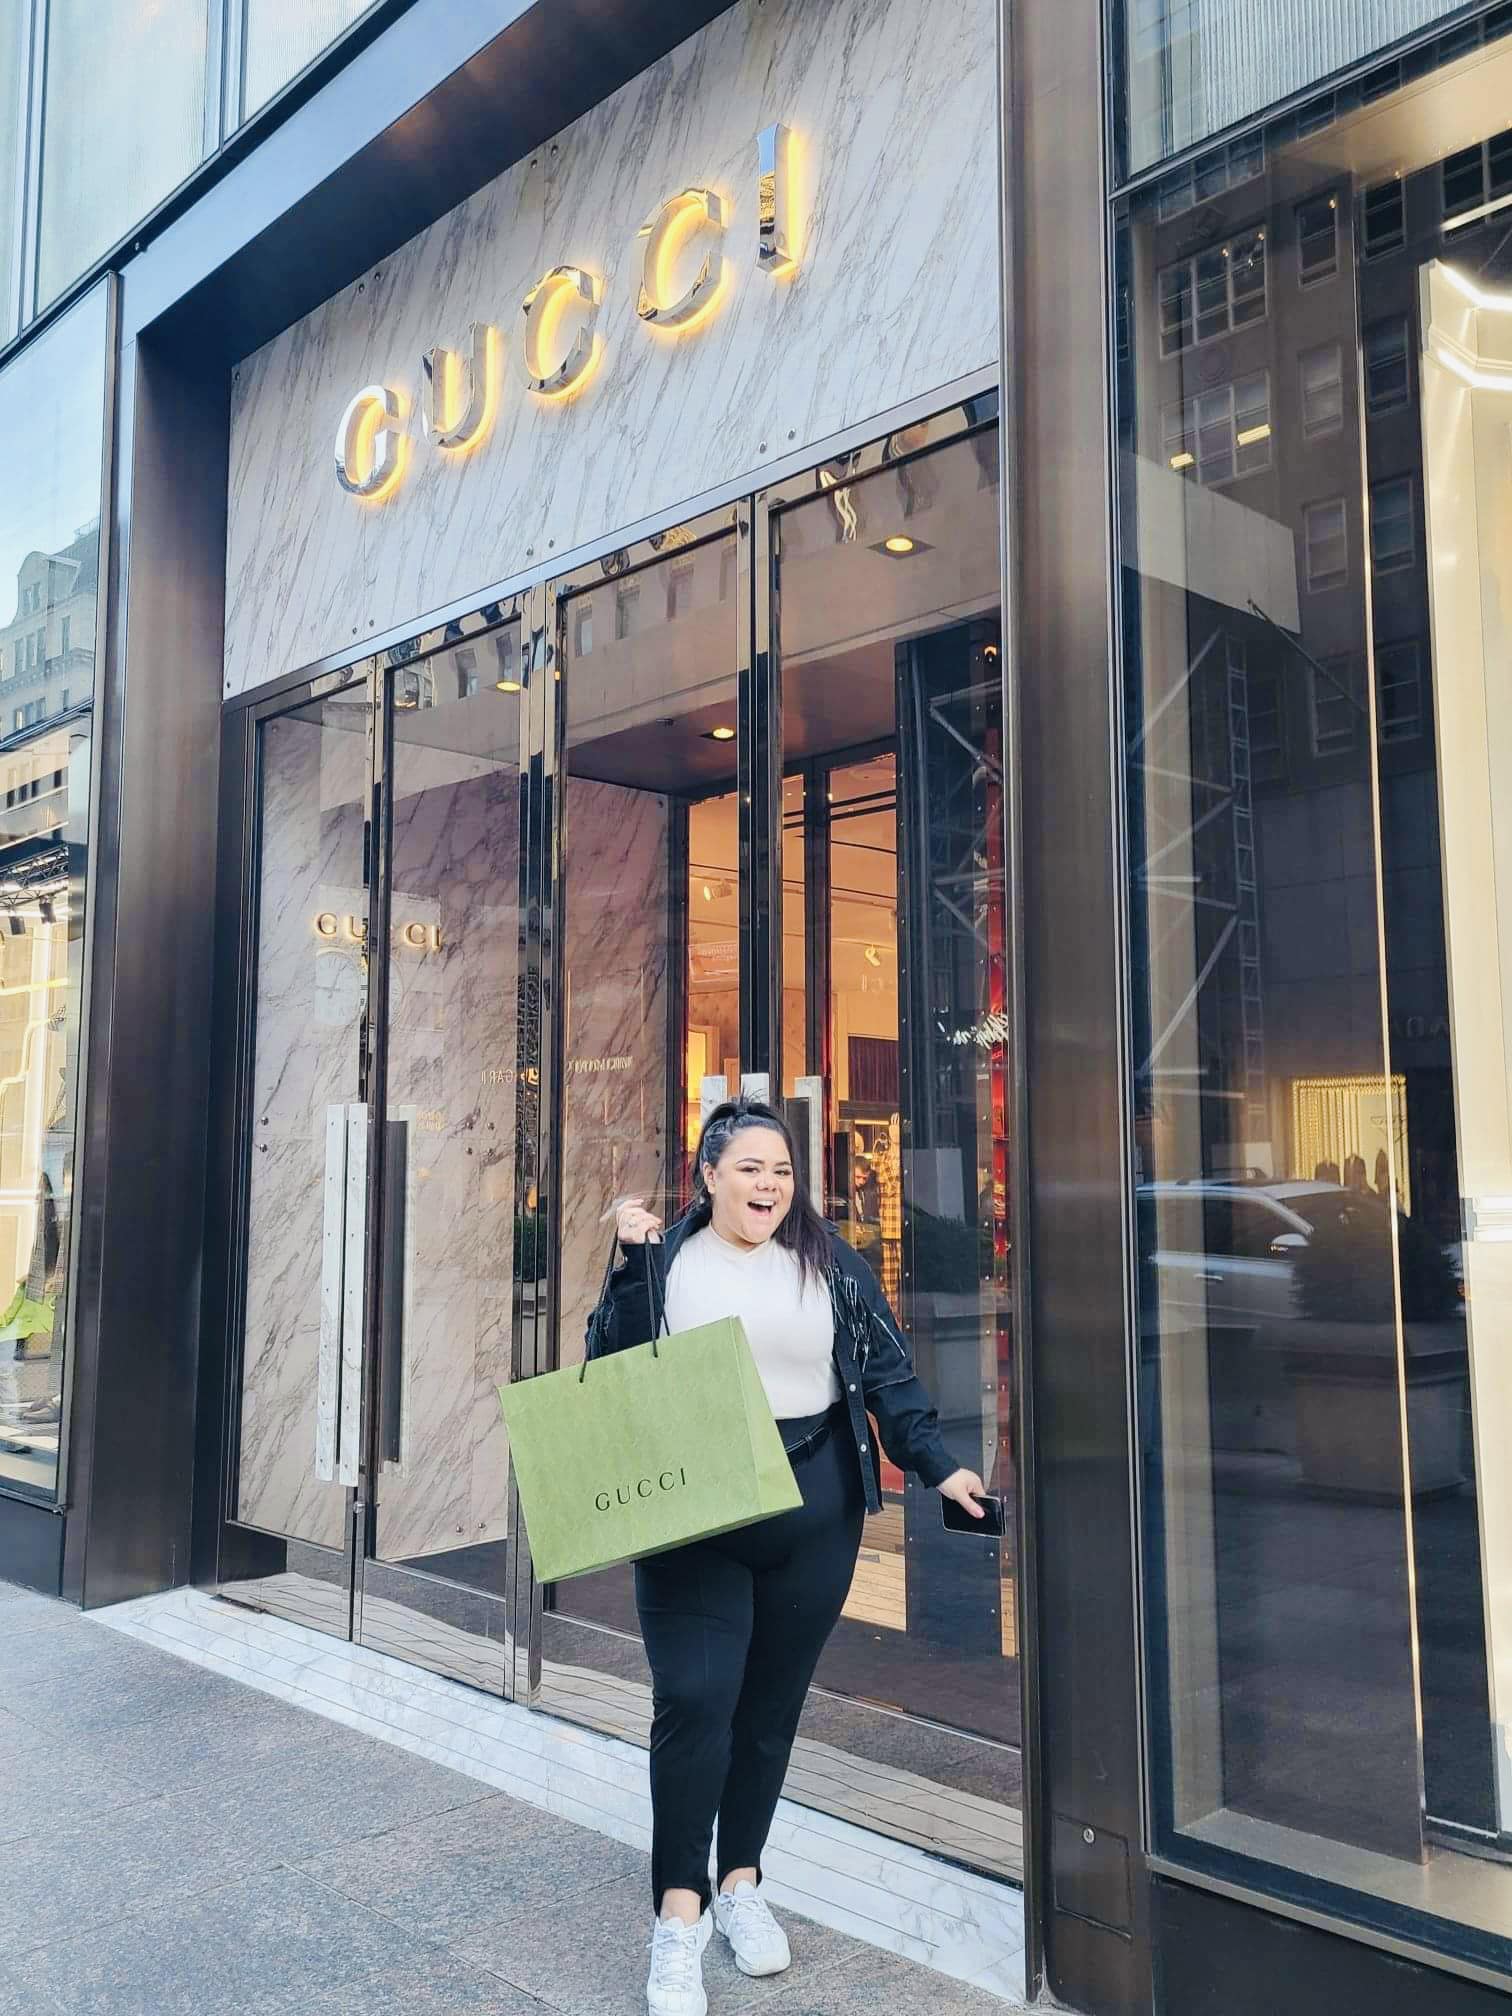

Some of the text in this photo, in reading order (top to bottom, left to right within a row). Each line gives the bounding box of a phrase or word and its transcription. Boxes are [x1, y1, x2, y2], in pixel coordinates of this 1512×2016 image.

[334, 122, 797, 499] GUCCI
[316, 912, 442, 948] GUCI
[595, 1467, 686, 1512] GUCCI
